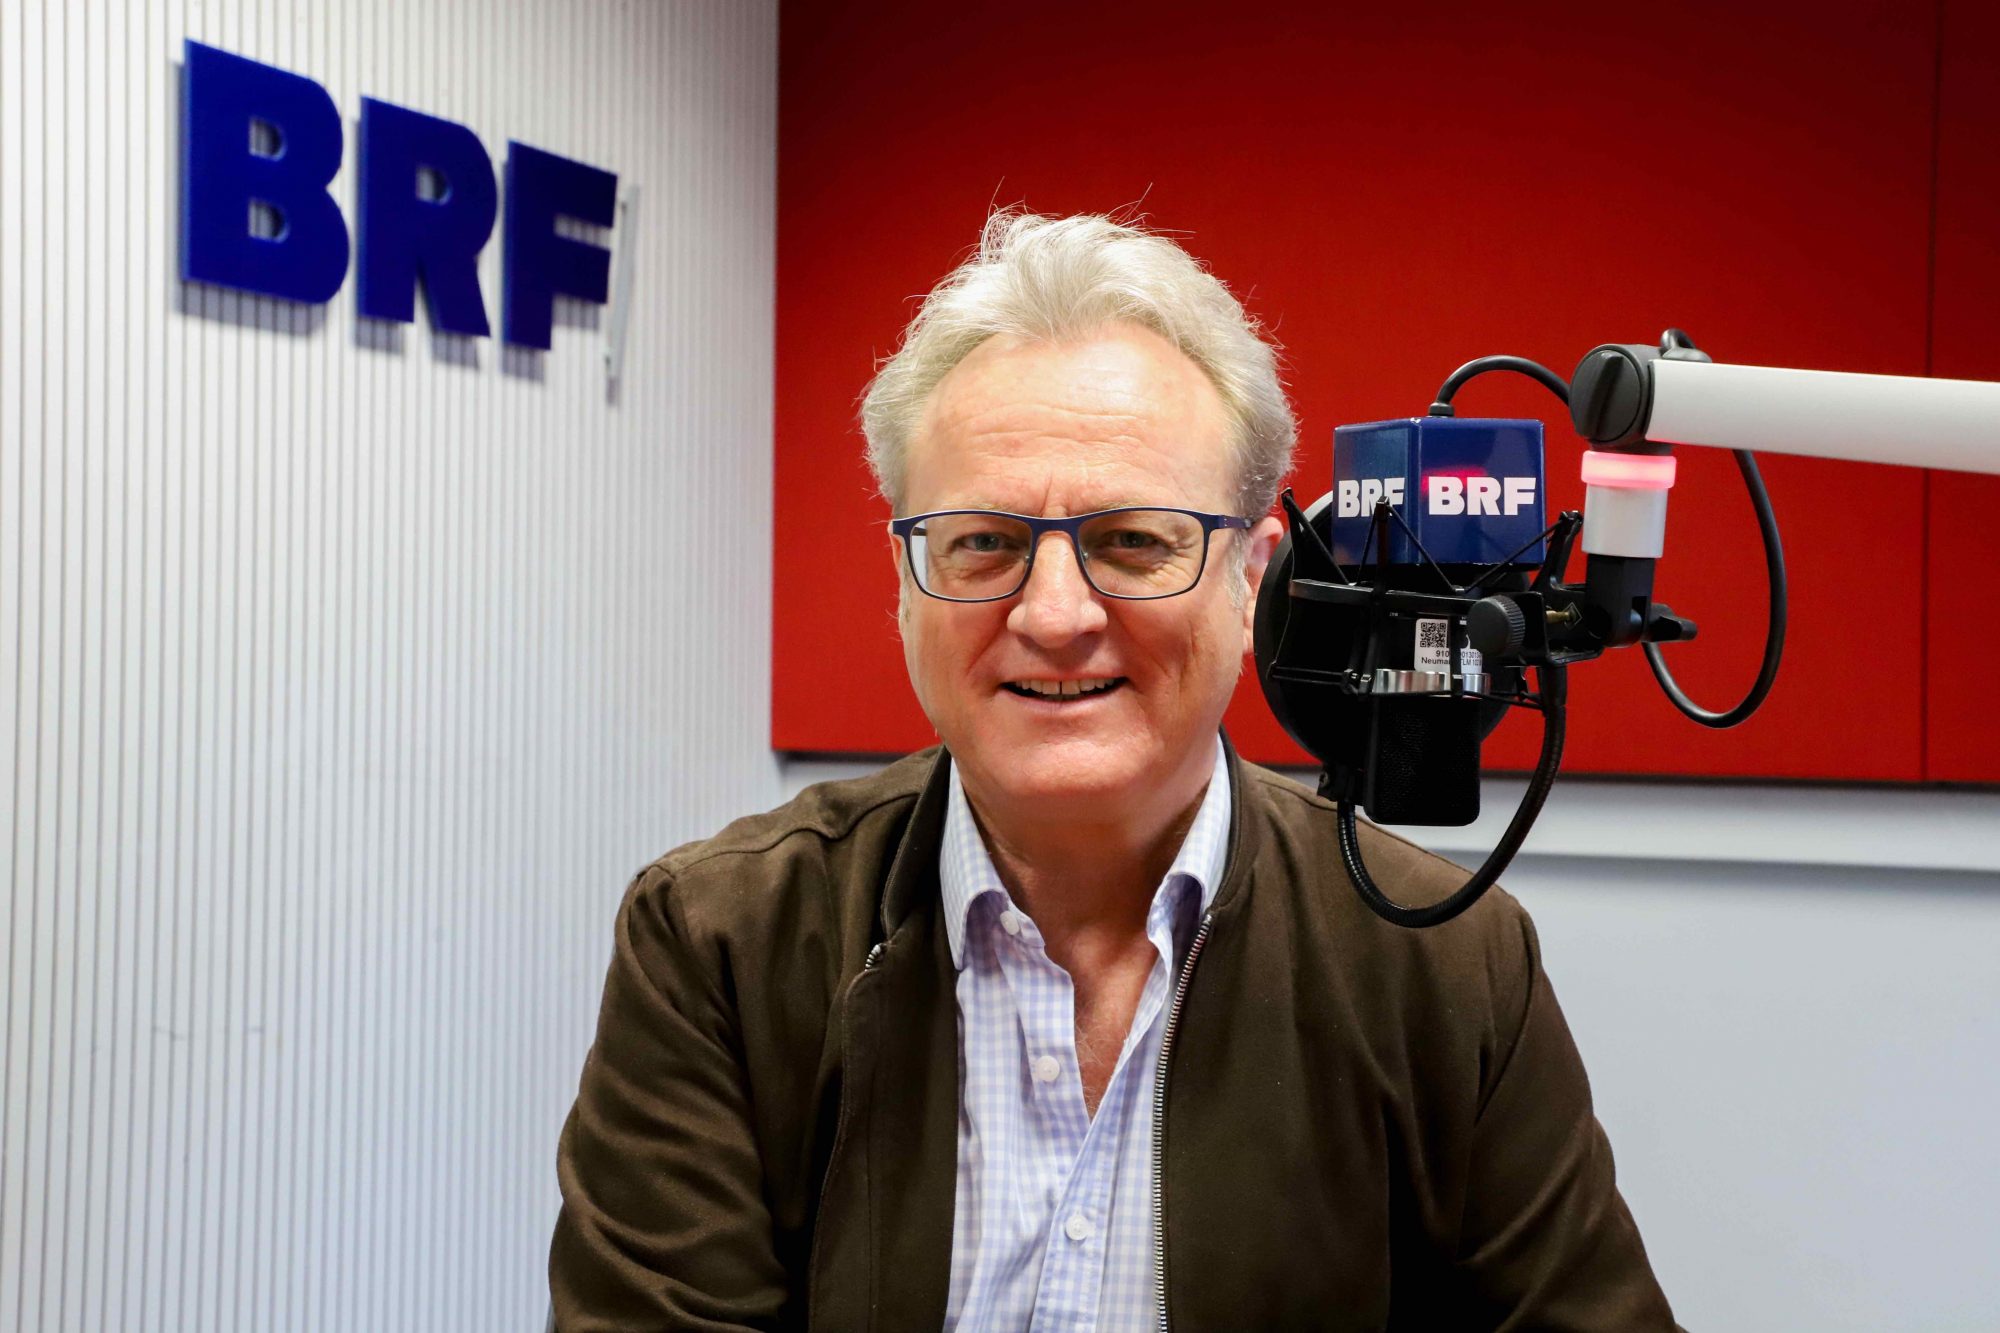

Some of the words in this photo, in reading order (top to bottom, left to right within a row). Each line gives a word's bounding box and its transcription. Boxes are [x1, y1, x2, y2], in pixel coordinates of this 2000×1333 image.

[182, 38, 618, 351] BRF
[1338, 477, 1405, 518] BRF
[1428, 476, 1537, 516] BRF
[1421, 657, 1450, 665] Neuma
